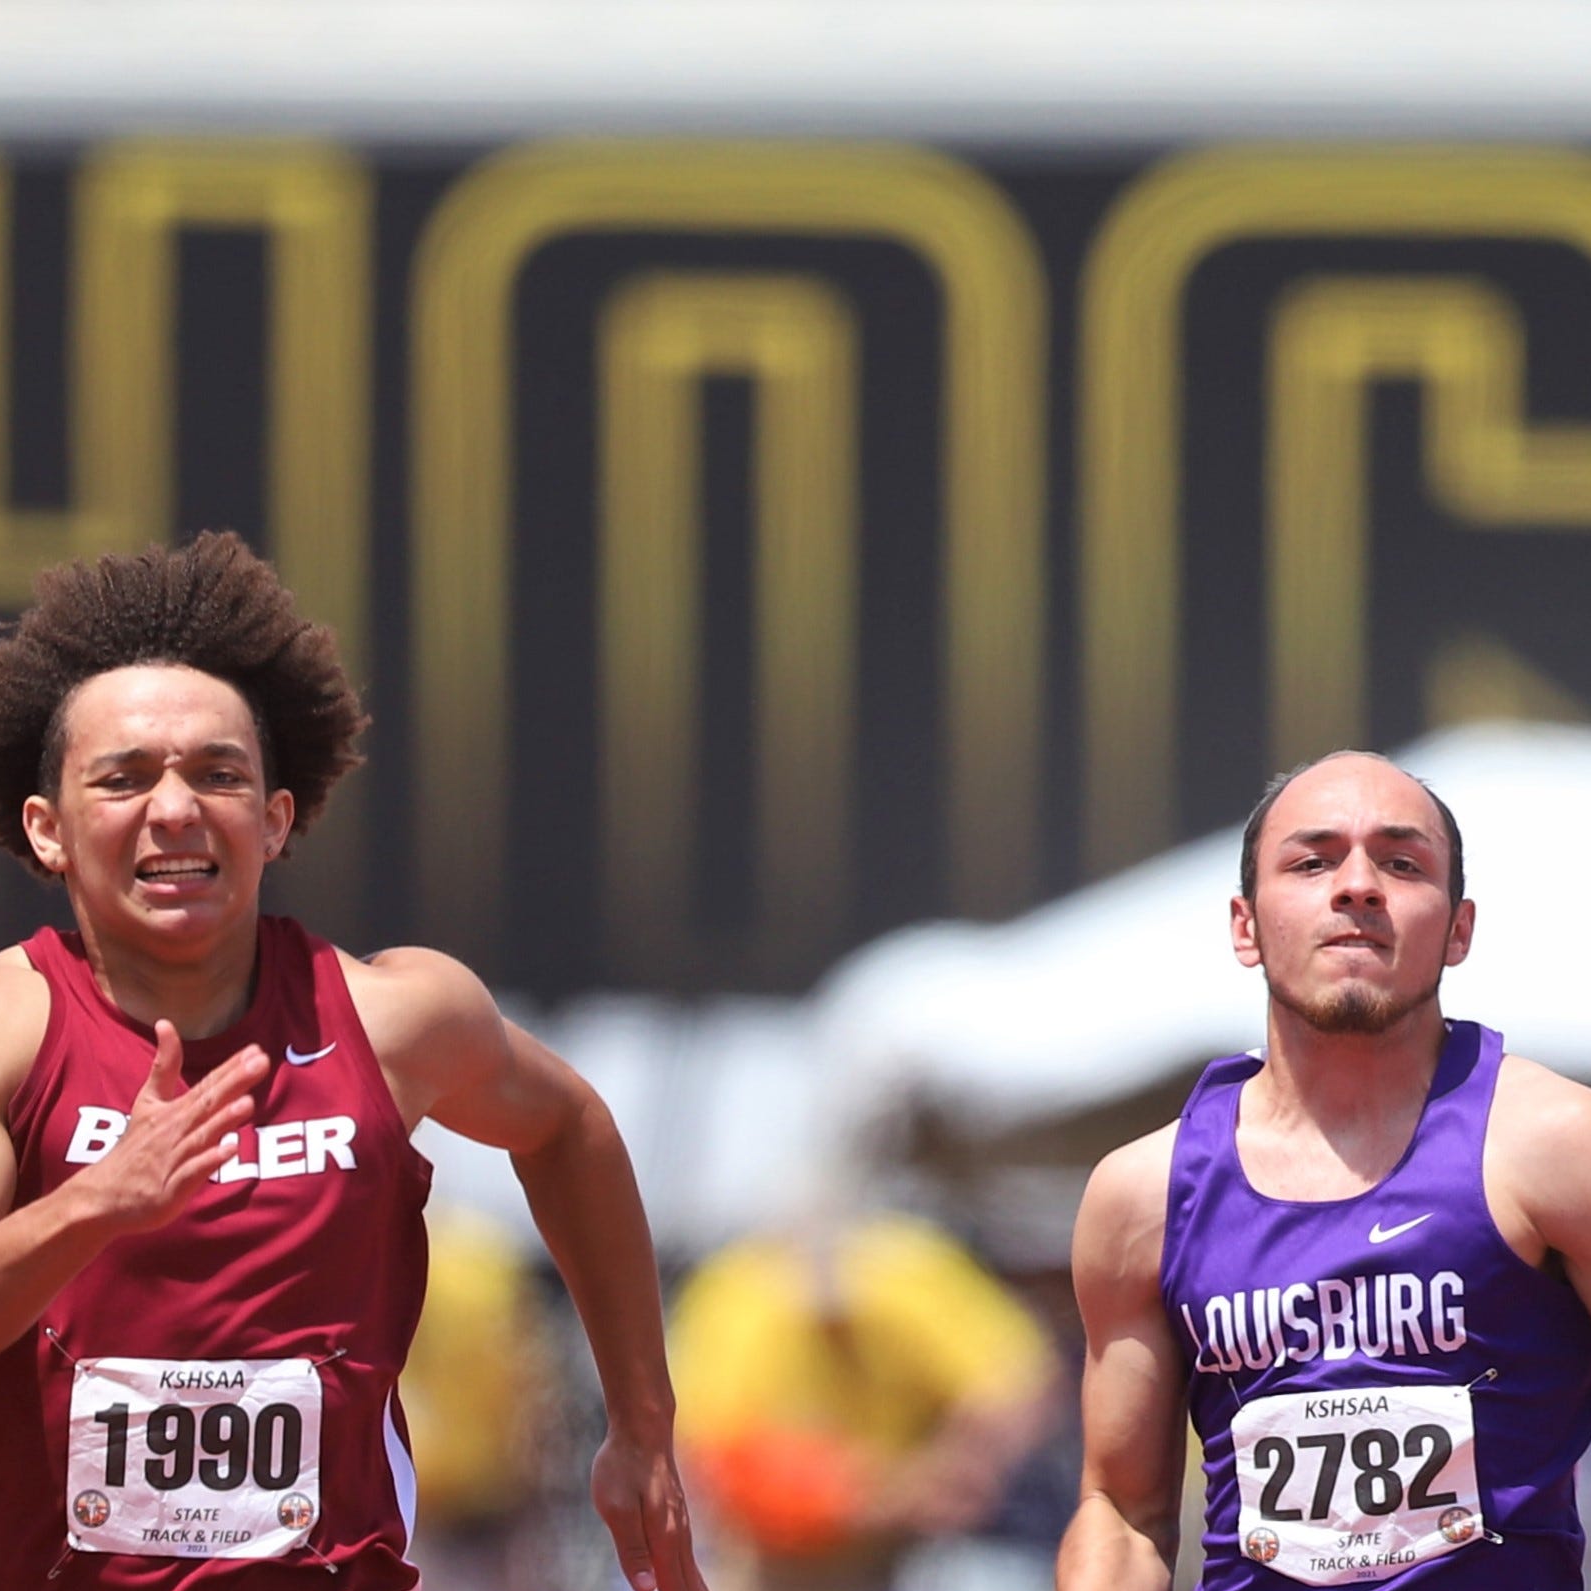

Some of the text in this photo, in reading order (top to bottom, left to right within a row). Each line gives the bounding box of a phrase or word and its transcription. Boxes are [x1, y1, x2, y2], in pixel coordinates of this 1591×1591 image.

[64, 1105, 358, 1185] BLER
[1181, 1270, 1468, 1375] LOUISBURG
[158, 1369, 246, 1391] KSHSAA
[1304, 1396, 1390, 1420] KSHSAA
[94, 1401, 303, 1492] 1990
[1253, 1423, 1458, 1523] 2782
[173, 1507, 221, 1522] STATE
[141, 1528, 252, 1543] TRACK & FIELD
[1336, 1531, 1382, 1549] STATE
[186, 1544, 209, 1554] 2021
[1310, 1550, 1416, 1572] TRACK & FIELD
[1355, 1569, 1377, 1579] 2021
